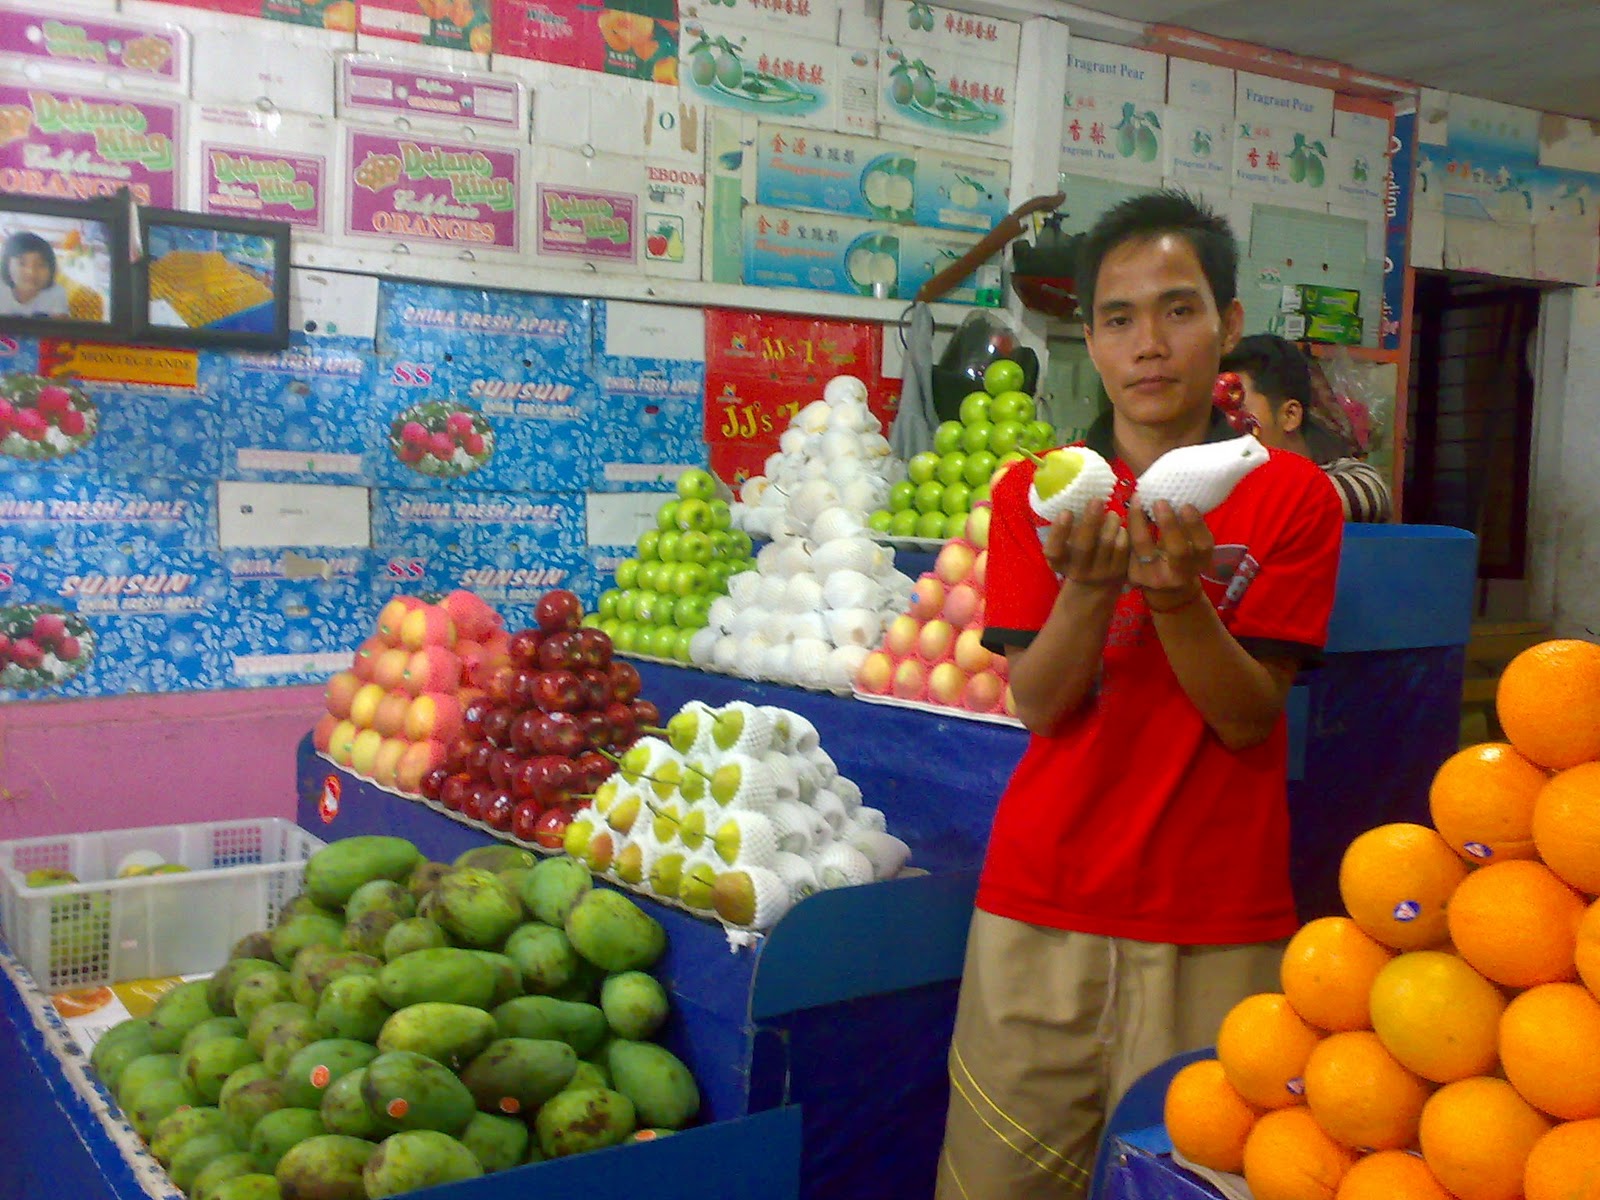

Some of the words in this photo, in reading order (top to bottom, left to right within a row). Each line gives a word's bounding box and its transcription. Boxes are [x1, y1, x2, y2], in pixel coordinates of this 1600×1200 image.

[1066, 53, 1117, 75] Fragrant
[1120, 63, 1145, 80] Pear
[1245, 88, 1290, 109] Fragrant
[397, 141, 493, 180] Delano
[450, 171, 515, 212] King
[371, 210, 496, 244] ORANGES
[390, 360, 435, 388] SS
[467, 378, 575, 402] SUNSUN
[384, 556, 427, 582] SS
[459, 567, 569, 587] SUNSUN
[57, 573, 197, 598] SUNSUN
